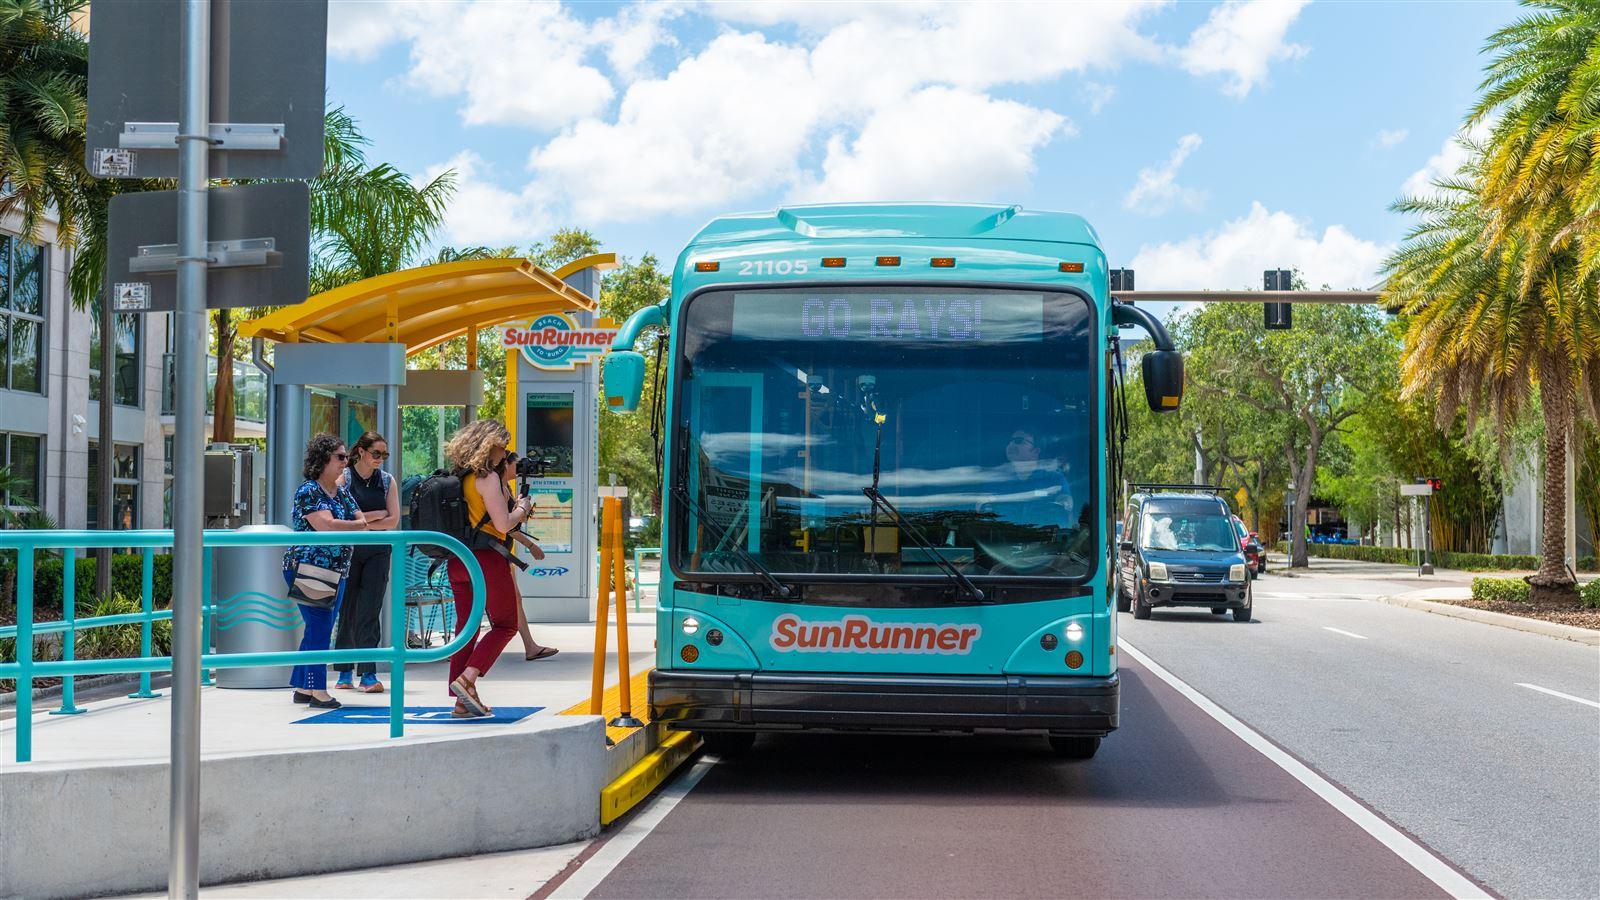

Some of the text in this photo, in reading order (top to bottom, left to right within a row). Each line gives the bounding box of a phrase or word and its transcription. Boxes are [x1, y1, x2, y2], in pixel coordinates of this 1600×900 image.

[738, 260, 808, 275] 21105
[538, 318, 562, 327] BEACH
[802, 298, 982, 339] GO RAYS!
[504, 327, 617, 345] SunRunner
[531, 566, 569, 576] PSTA
[774, 618, 977, 650] SunRunner
